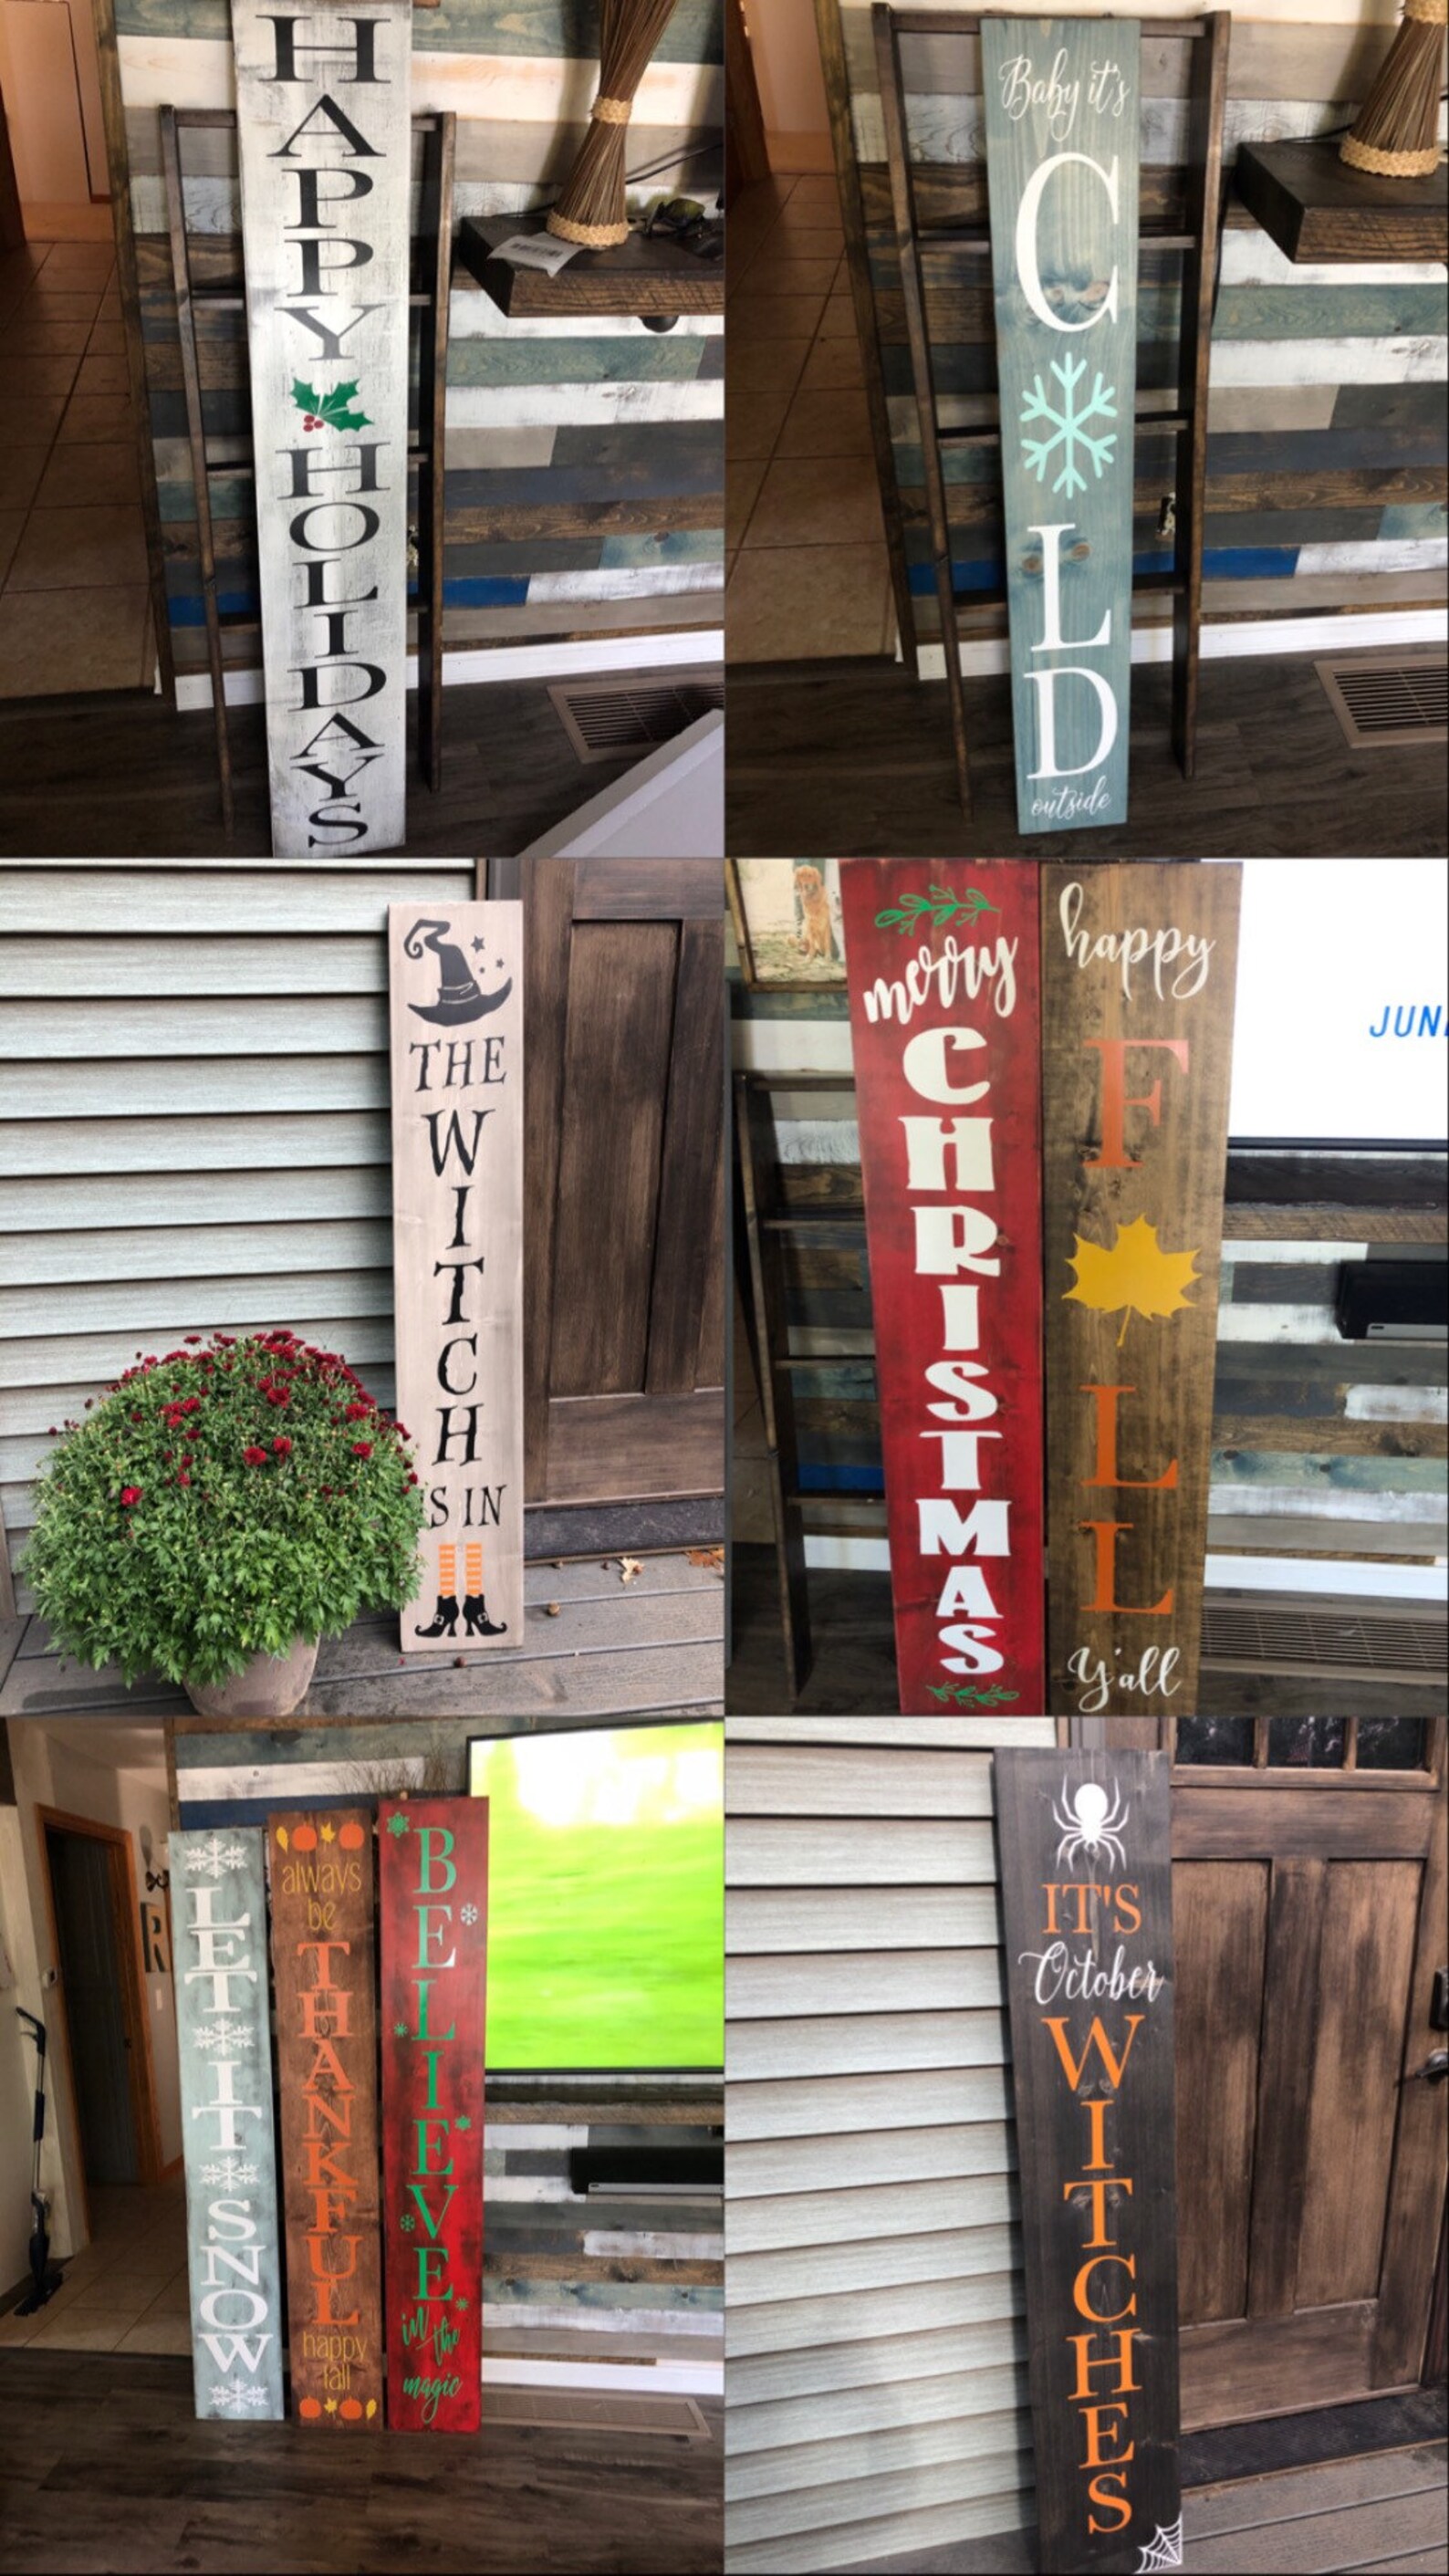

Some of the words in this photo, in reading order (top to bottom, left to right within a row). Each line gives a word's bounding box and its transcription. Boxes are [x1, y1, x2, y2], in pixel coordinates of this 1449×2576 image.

[998, 47, 1080, 142] Baby
[1088, 59, 1131, 117] it's
[256, 15, 392, 361] HAPPY
[277, 442, 391, 850] HOLIDAYS
[1030, 775, 1111, 820] outside
[1059, 882, 1216, 1002] happy
[863, 935, 1018, 1025] merry
[1370, 1005, 1448, 1037] JUN
[410, 1036, 507, 1092] THE
[422, 1109, 495, 1466] WITCH
[898, 1027, 1012, 1675] CHRISTMAS
[462, 1484, 507, 1528] IN
[1068, 1645, 1182, 1713] Y'all
[282, 1861, 362, 1895] always
[1041, 1882, 1142, 1935] IT'S
[308, 1898, 337, 1931] be
[184, 1886, 257, 2015] LET
[1018, 1940, 1165, 2006] October
[407, 1827, 458, 2302] BELIEVE
[192, 2060, 262, 2153] IT
[297, 1941, 369, 2326] THANKFUL
[198, 2199, 275, 2373] SNOW
[1041, 2014, 1146, 2535] WITCHES
[303, 2330, 369, 2362] happy
[401, 2305, 430, 2346] in
[415, 2316, 460, 2368] the
[323, 2362, 352, 2392] fall
[402, 2373, 464, 2425] magic
